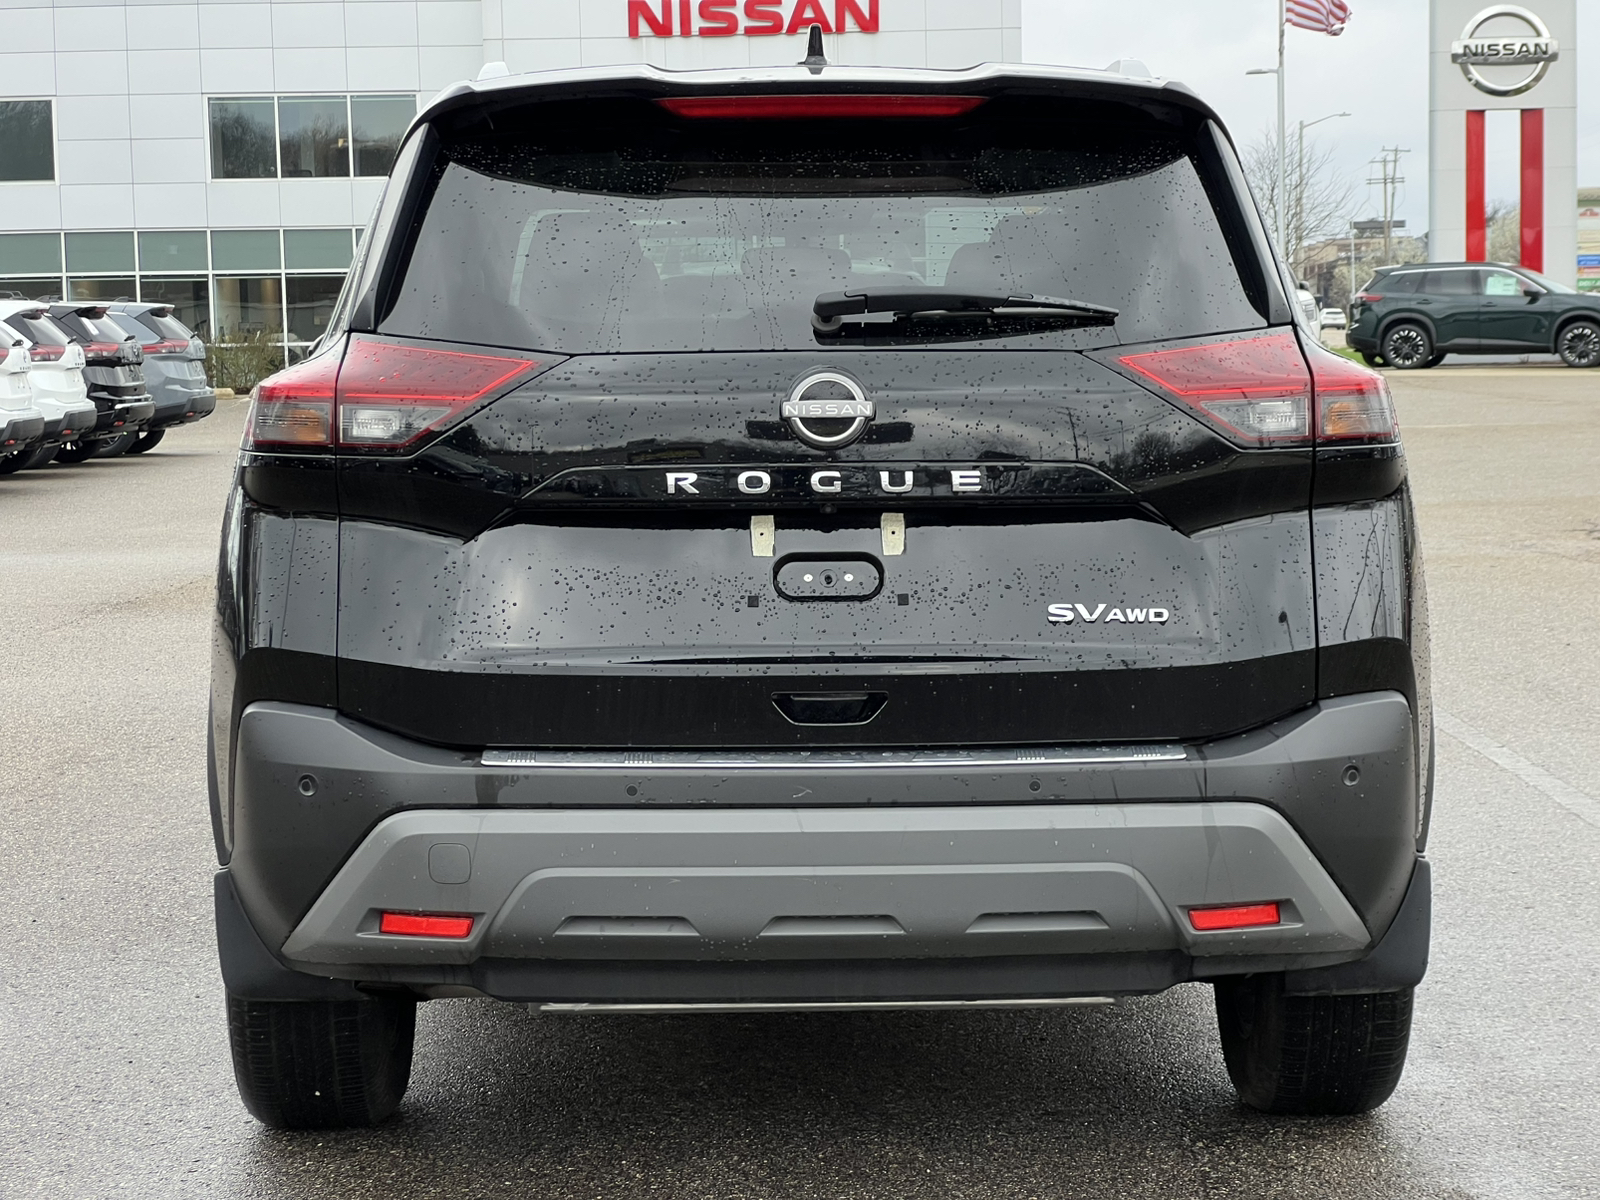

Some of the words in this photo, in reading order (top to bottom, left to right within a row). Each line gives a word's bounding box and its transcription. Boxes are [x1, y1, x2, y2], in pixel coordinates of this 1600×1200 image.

[628, 0, 879, 38] NISSAN
[1462, 42, 1549, 57] NISSAN
[785, 404, 871, 415] NISSAN
[665, 470, 982, 494] ROGUE
[1047, 603, 1107, 622] SV
[1104, 608, 1169, 622] AWD
